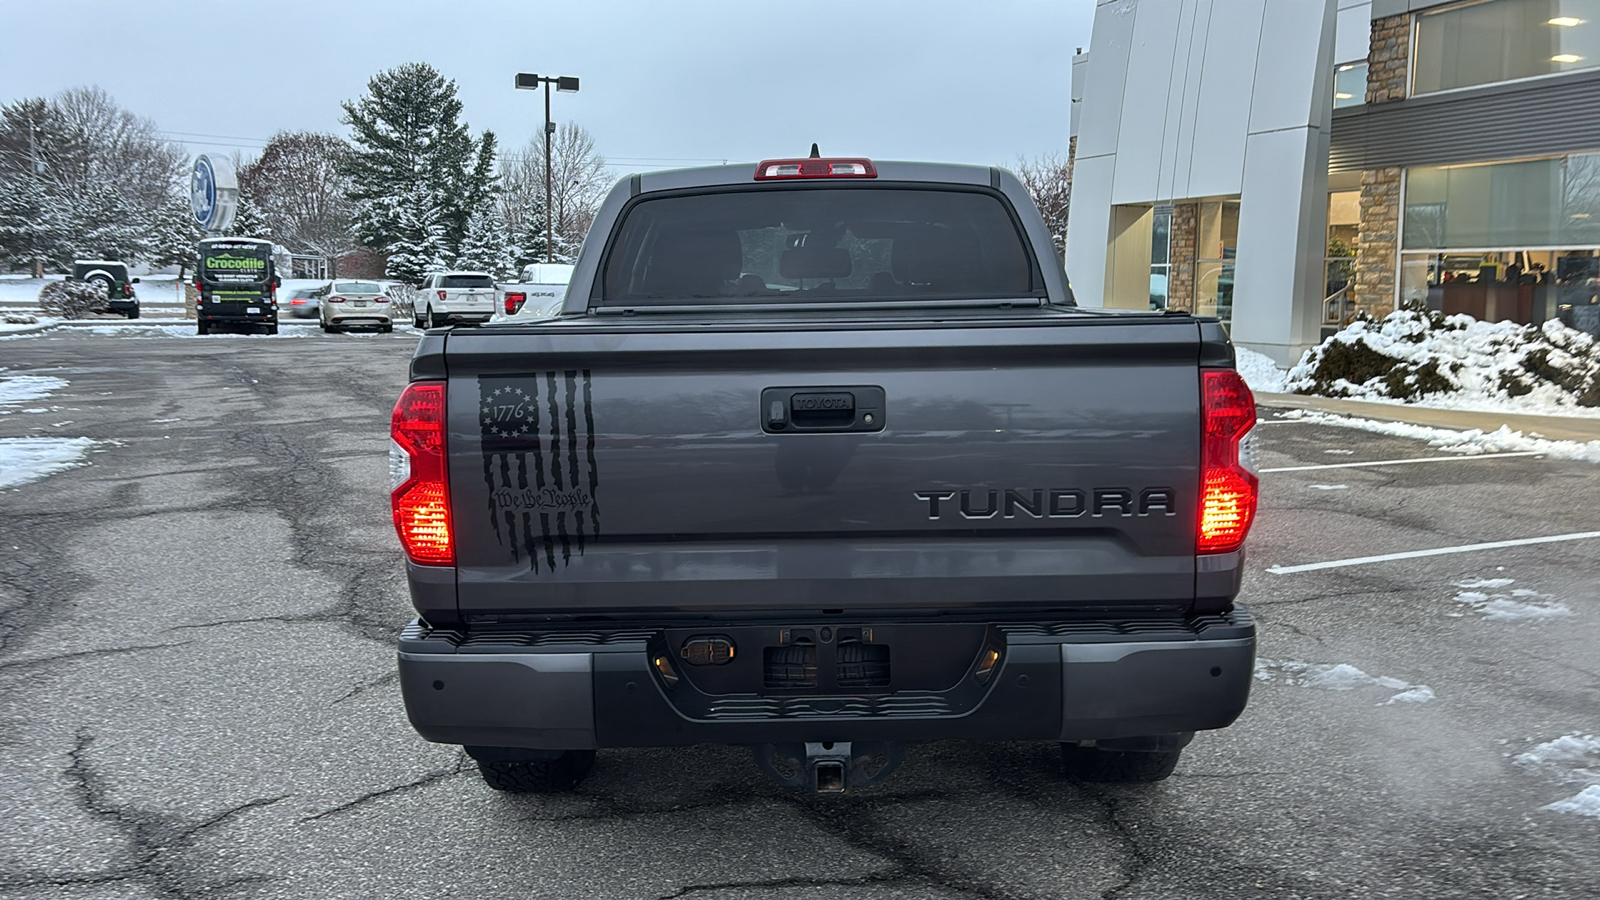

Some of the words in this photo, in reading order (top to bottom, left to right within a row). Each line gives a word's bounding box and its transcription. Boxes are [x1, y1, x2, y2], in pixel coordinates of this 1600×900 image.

[206, 257, 265, 269] Crocodile
[493, 403, 524, 422] 1776
[797, 399, 850, 409] TOYOTA
[494, 490, 522, 510] We
[542, 488, 591, 512] People
[914, 487, 1176, 520] TUNDRA
